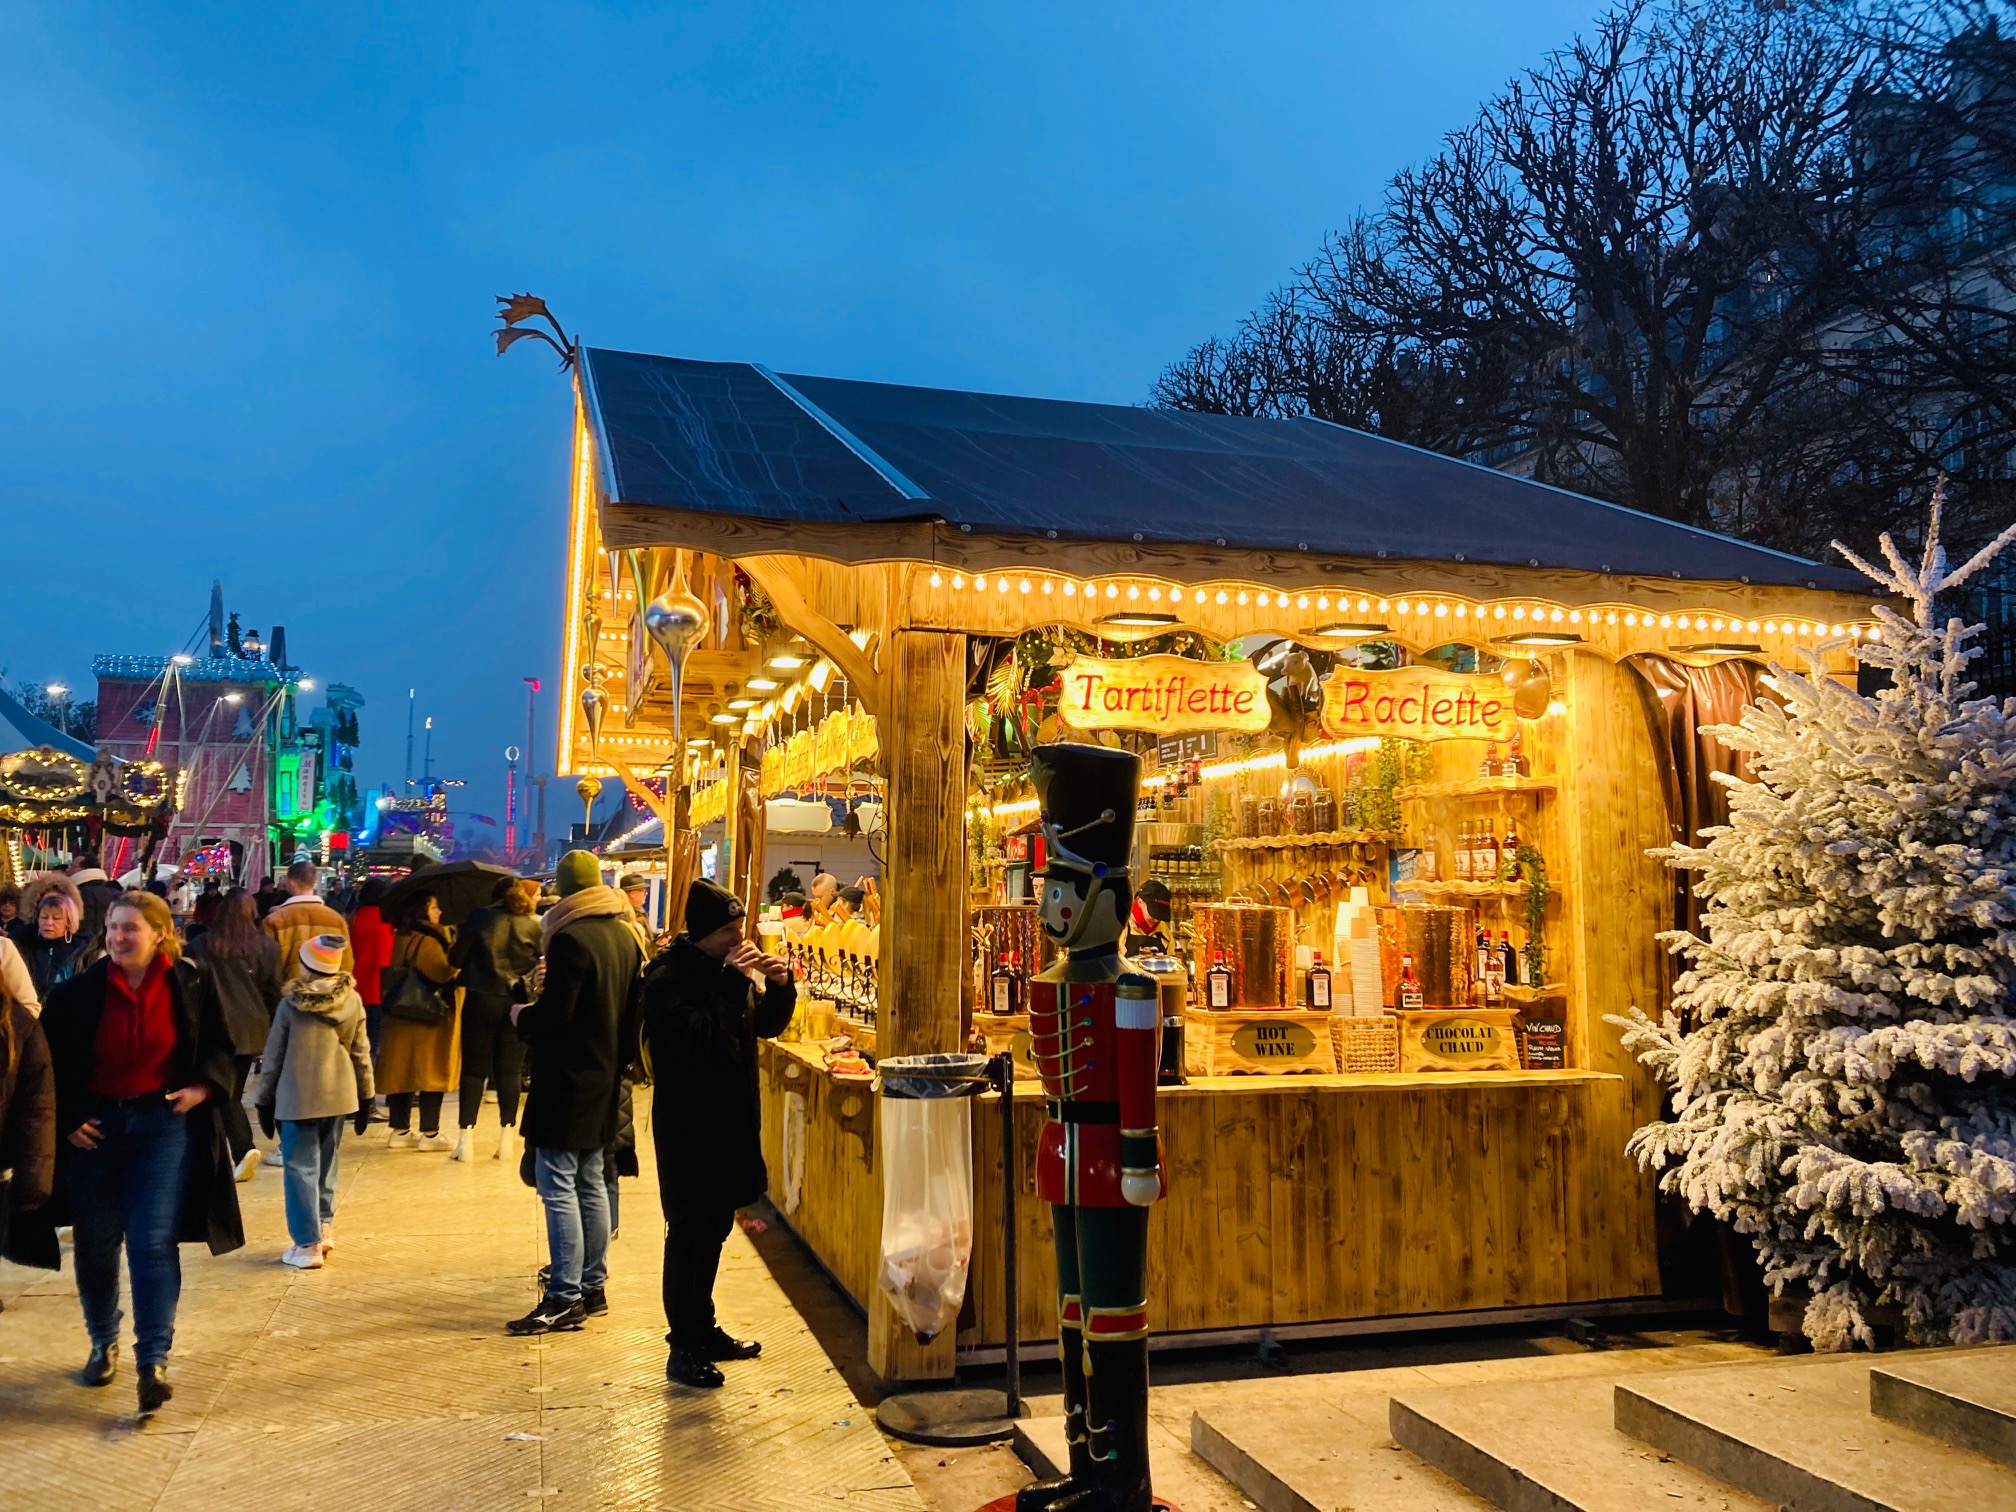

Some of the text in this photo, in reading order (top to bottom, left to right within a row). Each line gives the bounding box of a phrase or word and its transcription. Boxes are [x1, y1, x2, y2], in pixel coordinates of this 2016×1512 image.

[1075, 674, 1254, 721] Tartiflette
[1340, 681, 1503, 727] Raclette
[1256, 1026, 1289, 1040] HOT
[1426, 1027, 1494, 1040] CHOCOLAT
[1254, 1042, 1296, 1056] WINE
[1439, 1041, 1484, 1054] CHAUD
